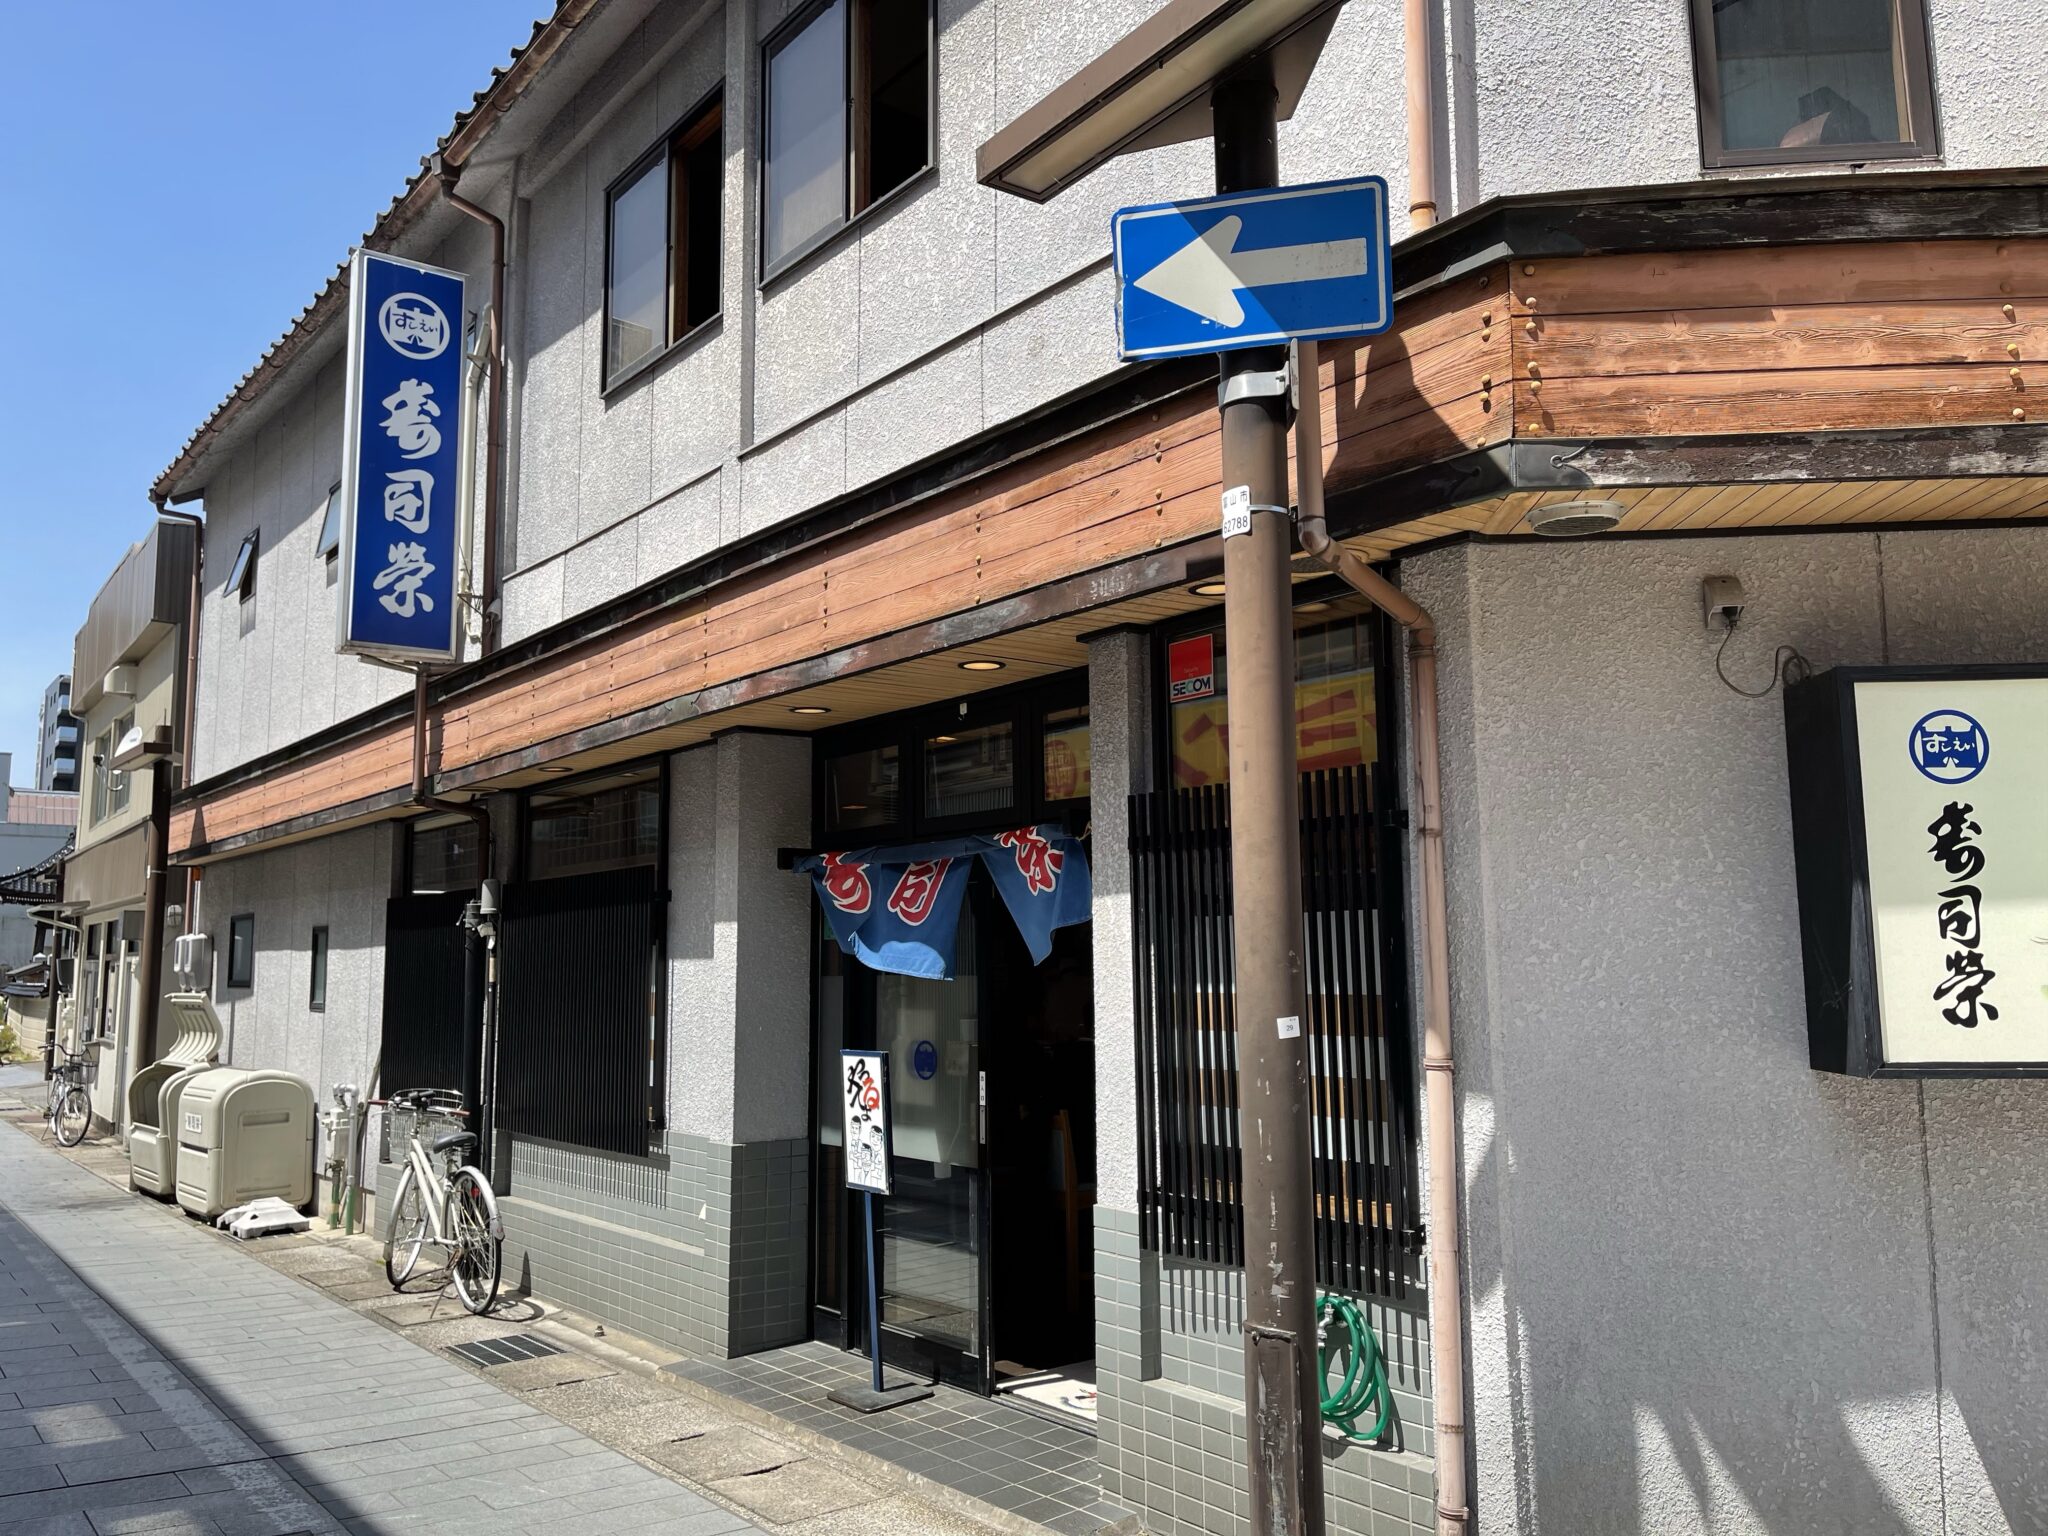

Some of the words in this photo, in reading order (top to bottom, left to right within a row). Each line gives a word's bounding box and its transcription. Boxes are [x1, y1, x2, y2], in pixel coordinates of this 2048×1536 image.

[392, 312, 438, 333] すしえい
[1223, 515, 1248, 534] 62788
[1173, 676, 1211, 697] SECOM
[1921, 732, 1976, 754] すしえい
[1286, 1024, 1294, 1032] 29
